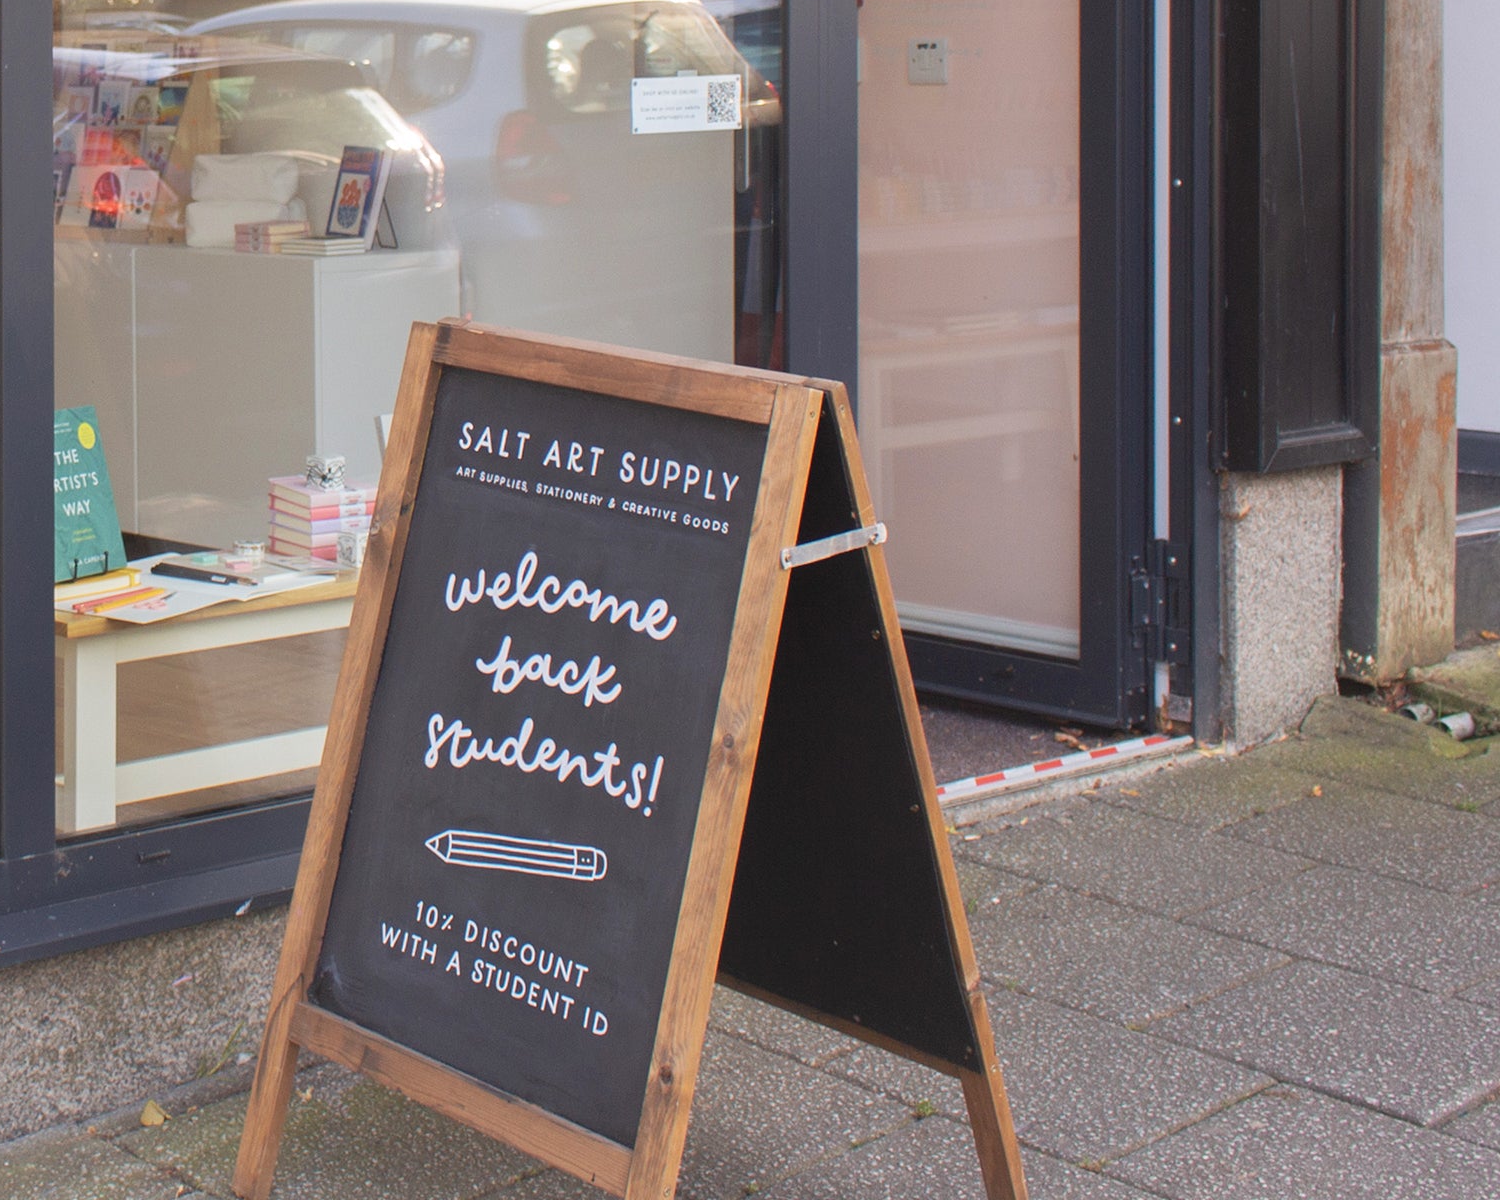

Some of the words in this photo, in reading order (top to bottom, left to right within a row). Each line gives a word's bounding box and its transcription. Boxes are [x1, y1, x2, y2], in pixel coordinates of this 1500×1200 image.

[54, 448, 80, 466] THE
[54, 471, 100, 493] RTIST'S
[458, 421, 531, 460] SALT
[542, 439, 605, 477] ART
[619, 451, 740, 502] SUPPLY
[62, 499, 91, 517] WAY
[455, 465, 477, 479] ART
[479, 471, 529, 493] SUPPLIES,
[535, 482, 603, 506] STATIONERY
[607, 497, 616, 509] &
[621, 500, 677, 523] CREATIVE
[683, 513, 729, 535] GOODS
[445, 551, 678, 641] welcome
[475, 635, 622, 708] back
[424, 713, 665, 817] students!
[381, 922, 438, 965] WITH
[445, 950, 461, 977] A
[471, 958, 575, 1020] STUDENT
[583, 1006, 609, 1036] ID
[416, 900, 454, 931] 10%
[464, 919, 589, 988] DISCOUNT
